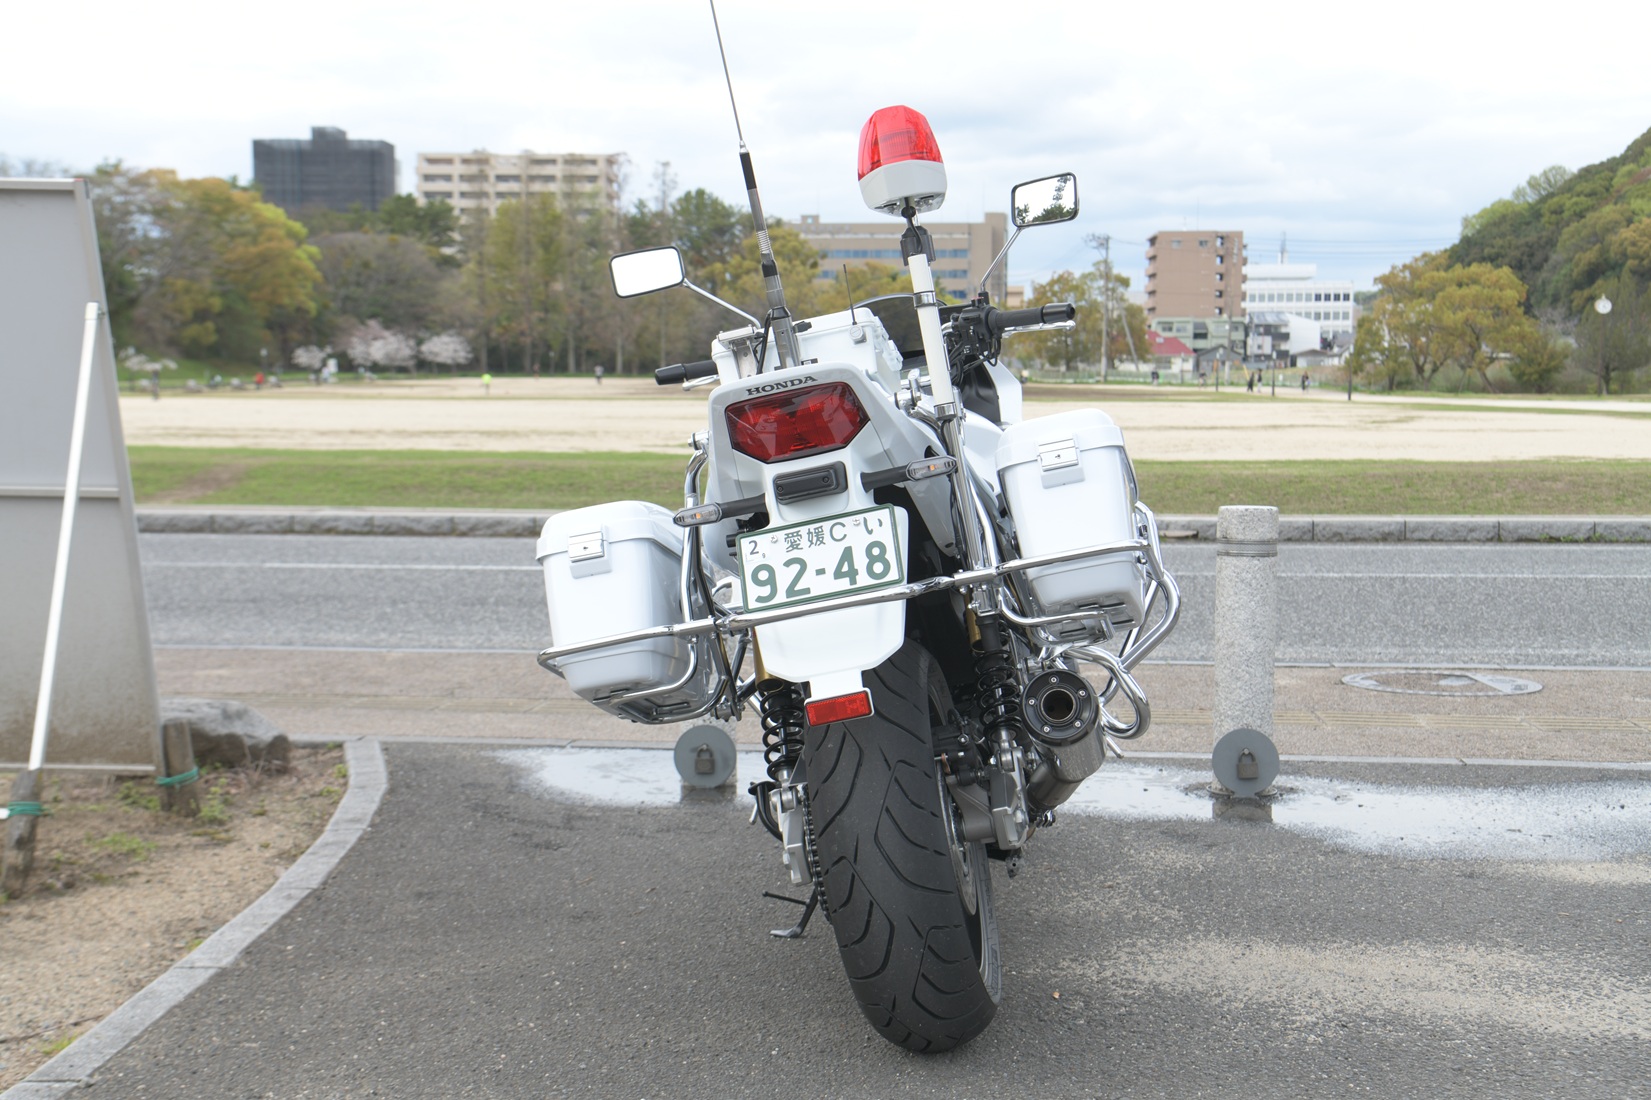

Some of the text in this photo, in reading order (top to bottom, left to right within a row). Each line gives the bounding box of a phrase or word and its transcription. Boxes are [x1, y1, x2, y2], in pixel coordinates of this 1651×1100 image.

[746, 376, 818, 395] HONDA
[748, 540, 760, 555] 2
[751, 541, 891, 604] 92-48
